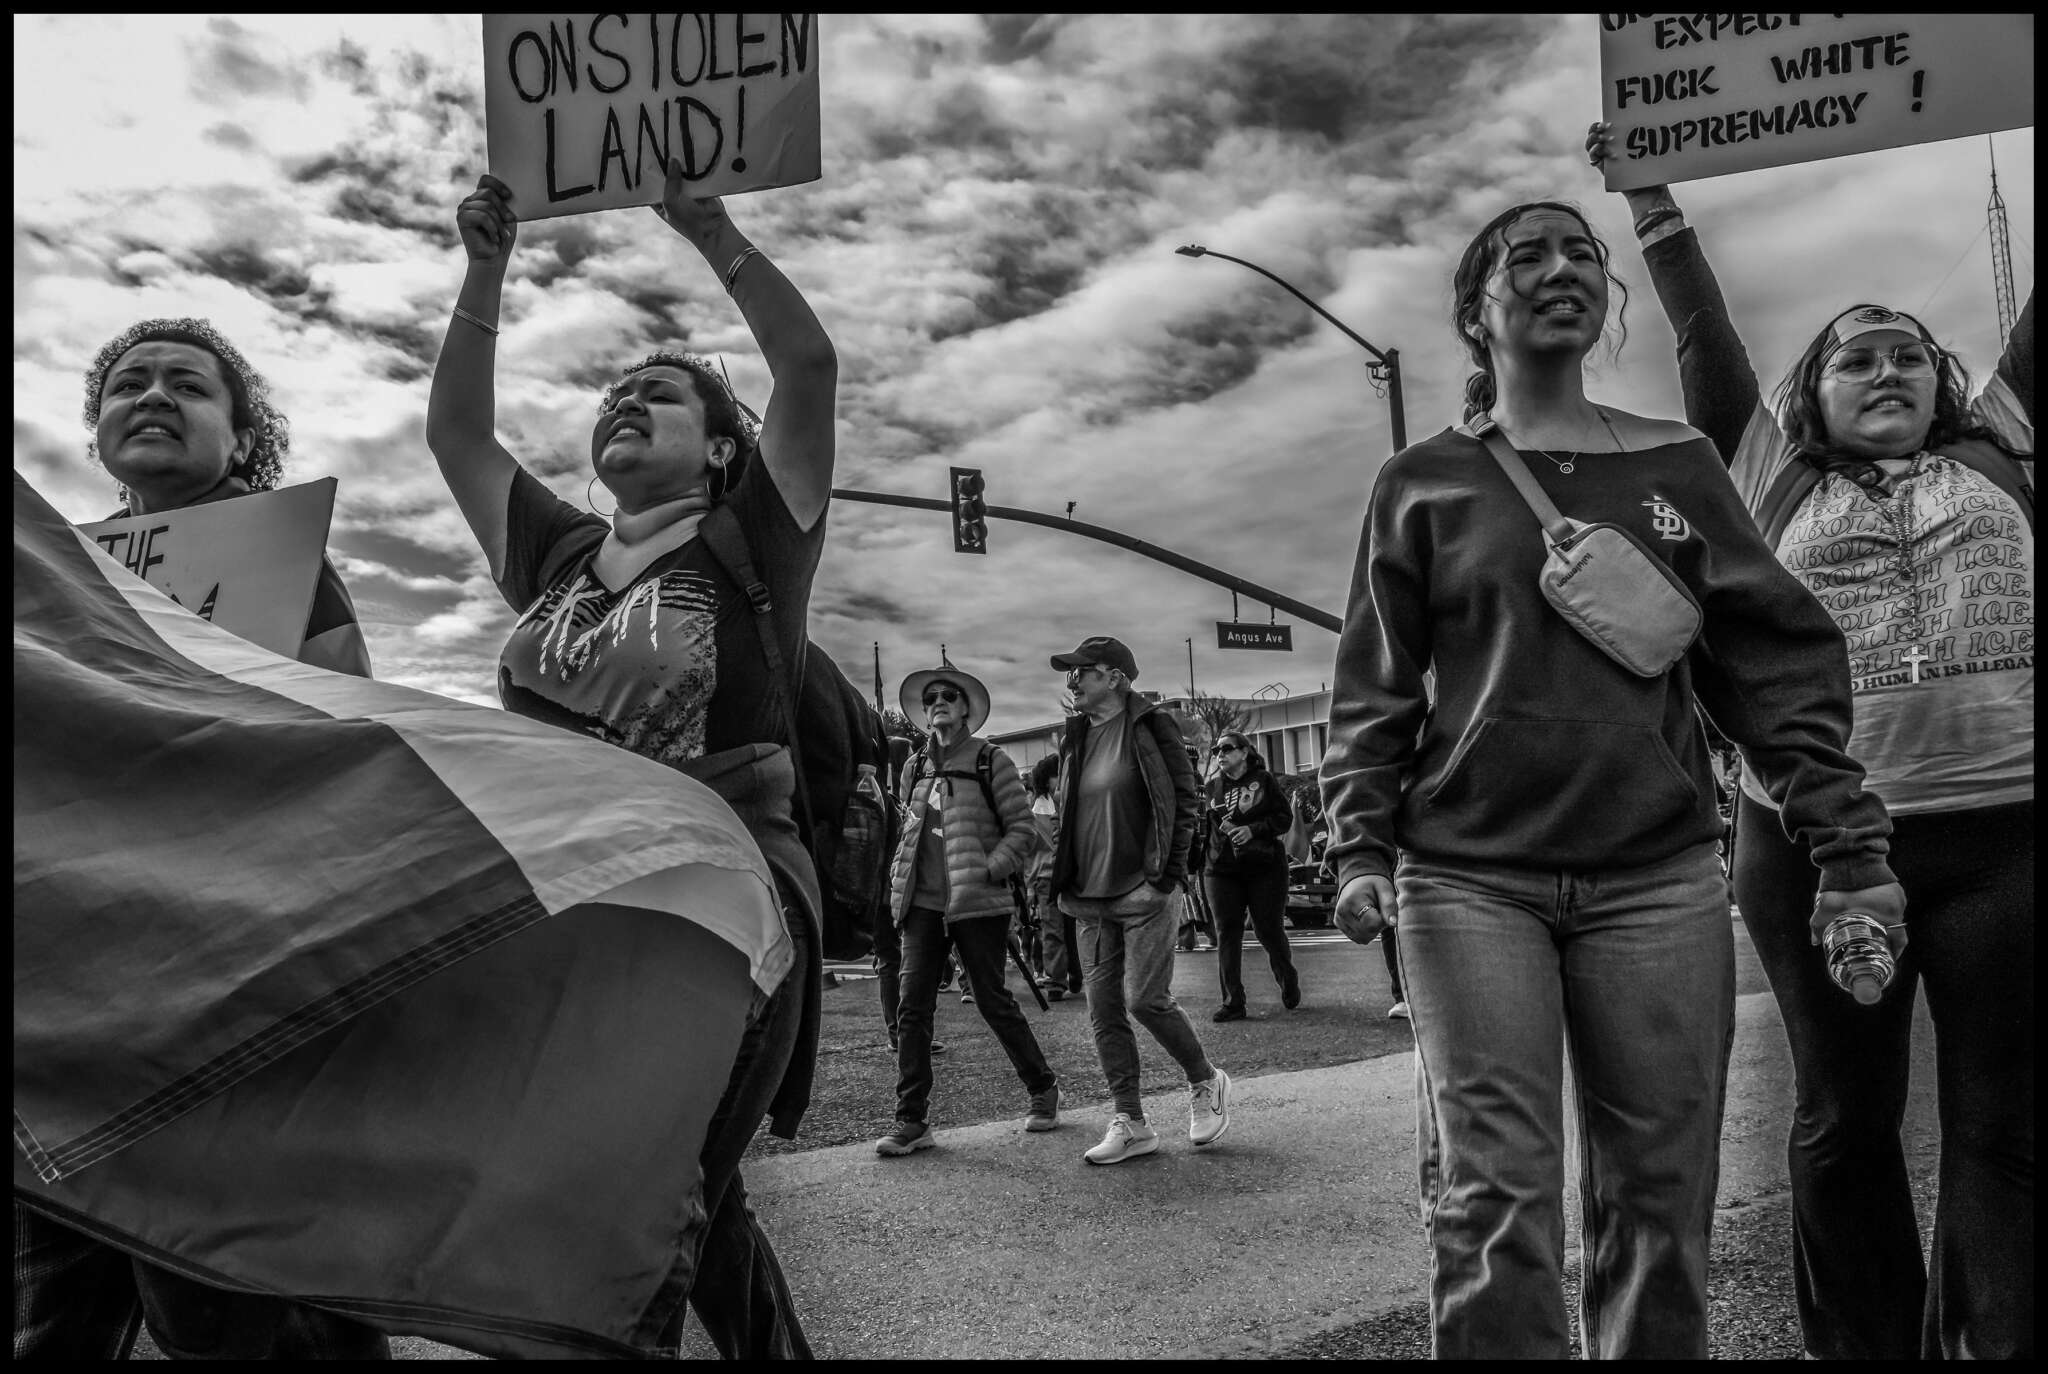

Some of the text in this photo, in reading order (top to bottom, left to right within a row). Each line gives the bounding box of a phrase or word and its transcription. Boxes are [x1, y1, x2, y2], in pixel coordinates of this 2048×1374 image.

[1616, 31, 1911, 109] FUCK WHITE
[1625, 91, 1869, 160] SUPREMACY
[545, 84, 748, 202] LAND!
[1951, 515, 2023, 547] I.C.E.
[1556, 552, 1593, 588] lululemon
[1955, 543, 2028, 573] I.C.E.
[1961, 571, 2032, 598] I.C.E.
[1964, 600, 2034, 628] I.C.E.
[1227, 631, 1283, 644] Angus Ave
[1863, 667, 1941, 690] HUMN
[1943, 663, 1963, 677] IS
[1965, 656, 2034, 674] ILLEGA
